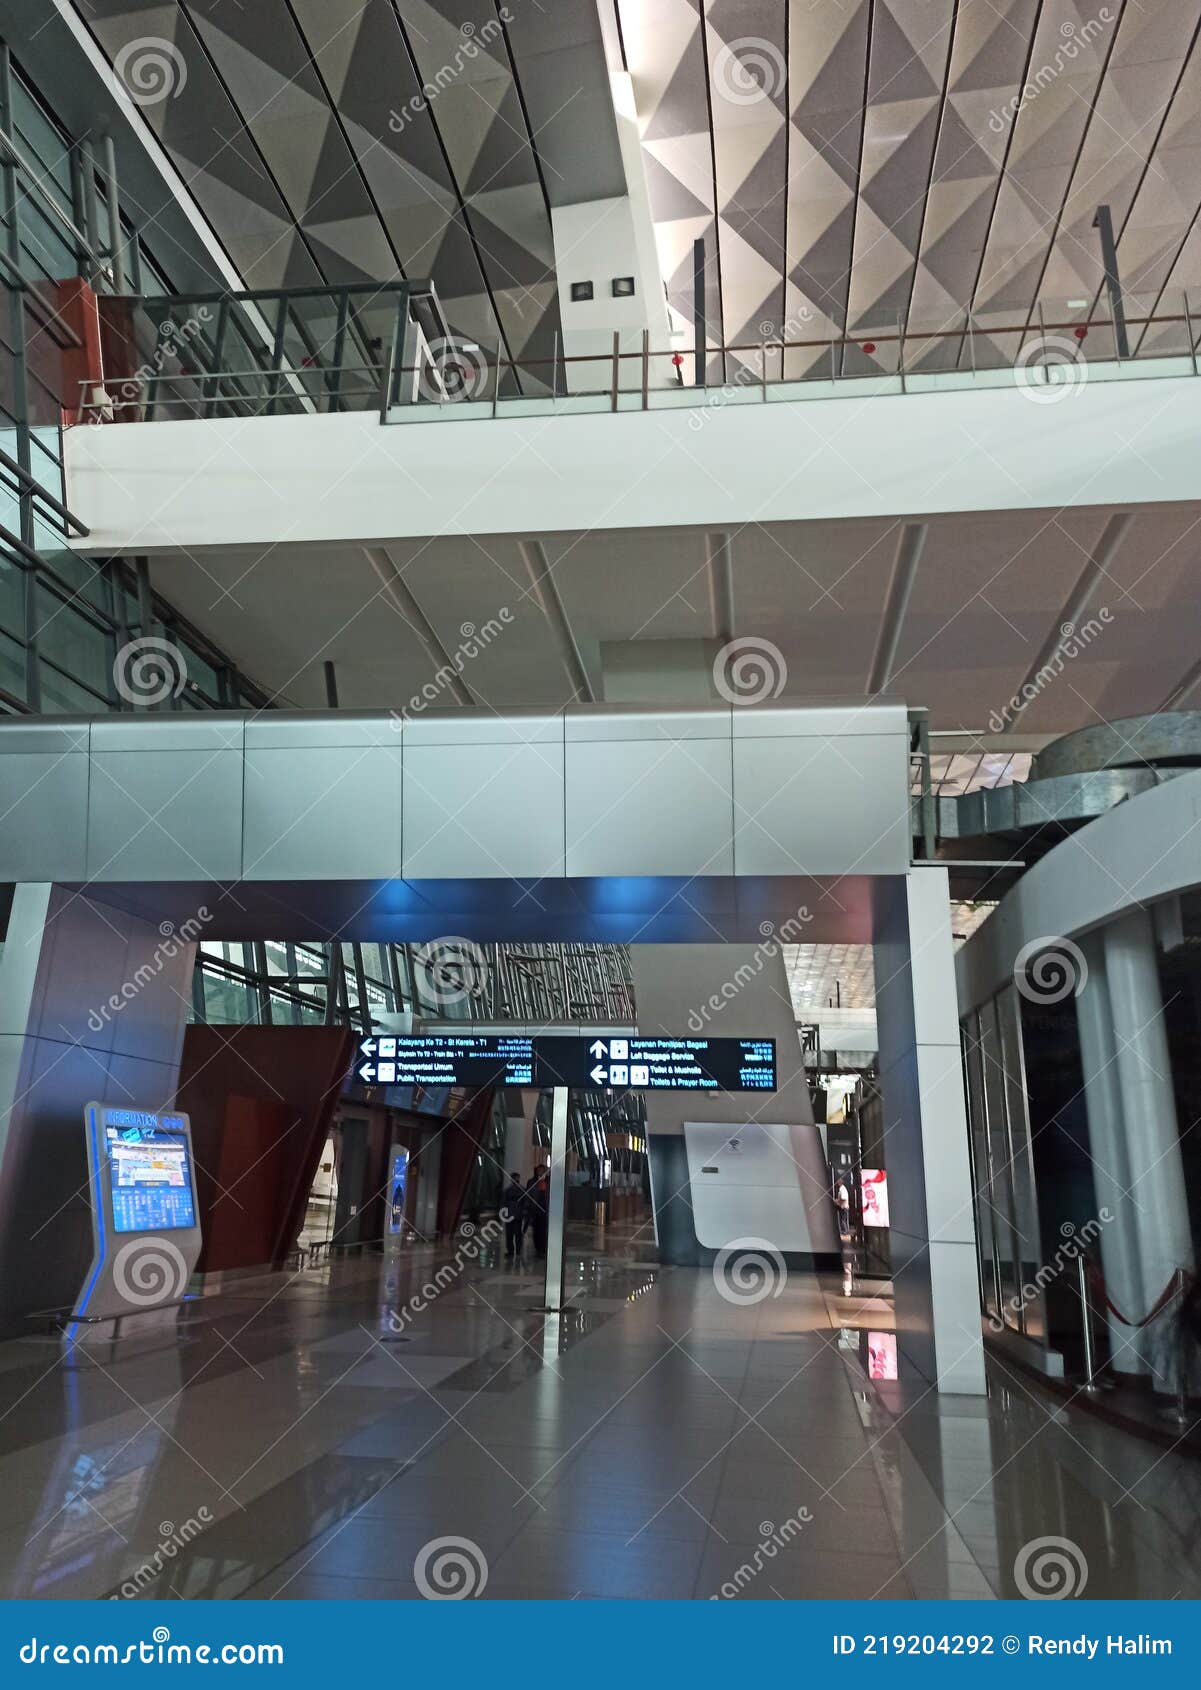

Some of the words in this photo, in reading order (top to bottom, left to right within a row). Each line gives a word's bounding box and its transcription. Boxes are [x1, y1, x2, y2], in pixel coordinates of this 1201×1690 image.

[435, 1038, 443, 1046] T2
[479, 1038, 487, 1046] T1
[630, 1040, 657, 1049] Layanan
[686, 1040, 708, 1050] Bagasi
[643, 1052, 670, 1061] Baggage
[671, 1052, 694, 1060] Service
[397, 1063, 433, 1071] Transportasi
[434, 1063, 453, 1071] Umum
[650, 1065, 667, 1074] Toilet
[396, 1074, 415, 1082] Public
[415, 1074, 457, 1083] Transportation
[677, 1078, 698, 1087] Prayer
[698, 1079, 718, 1087] Room
[107, 1110, 158, 1126] INFORMATION
